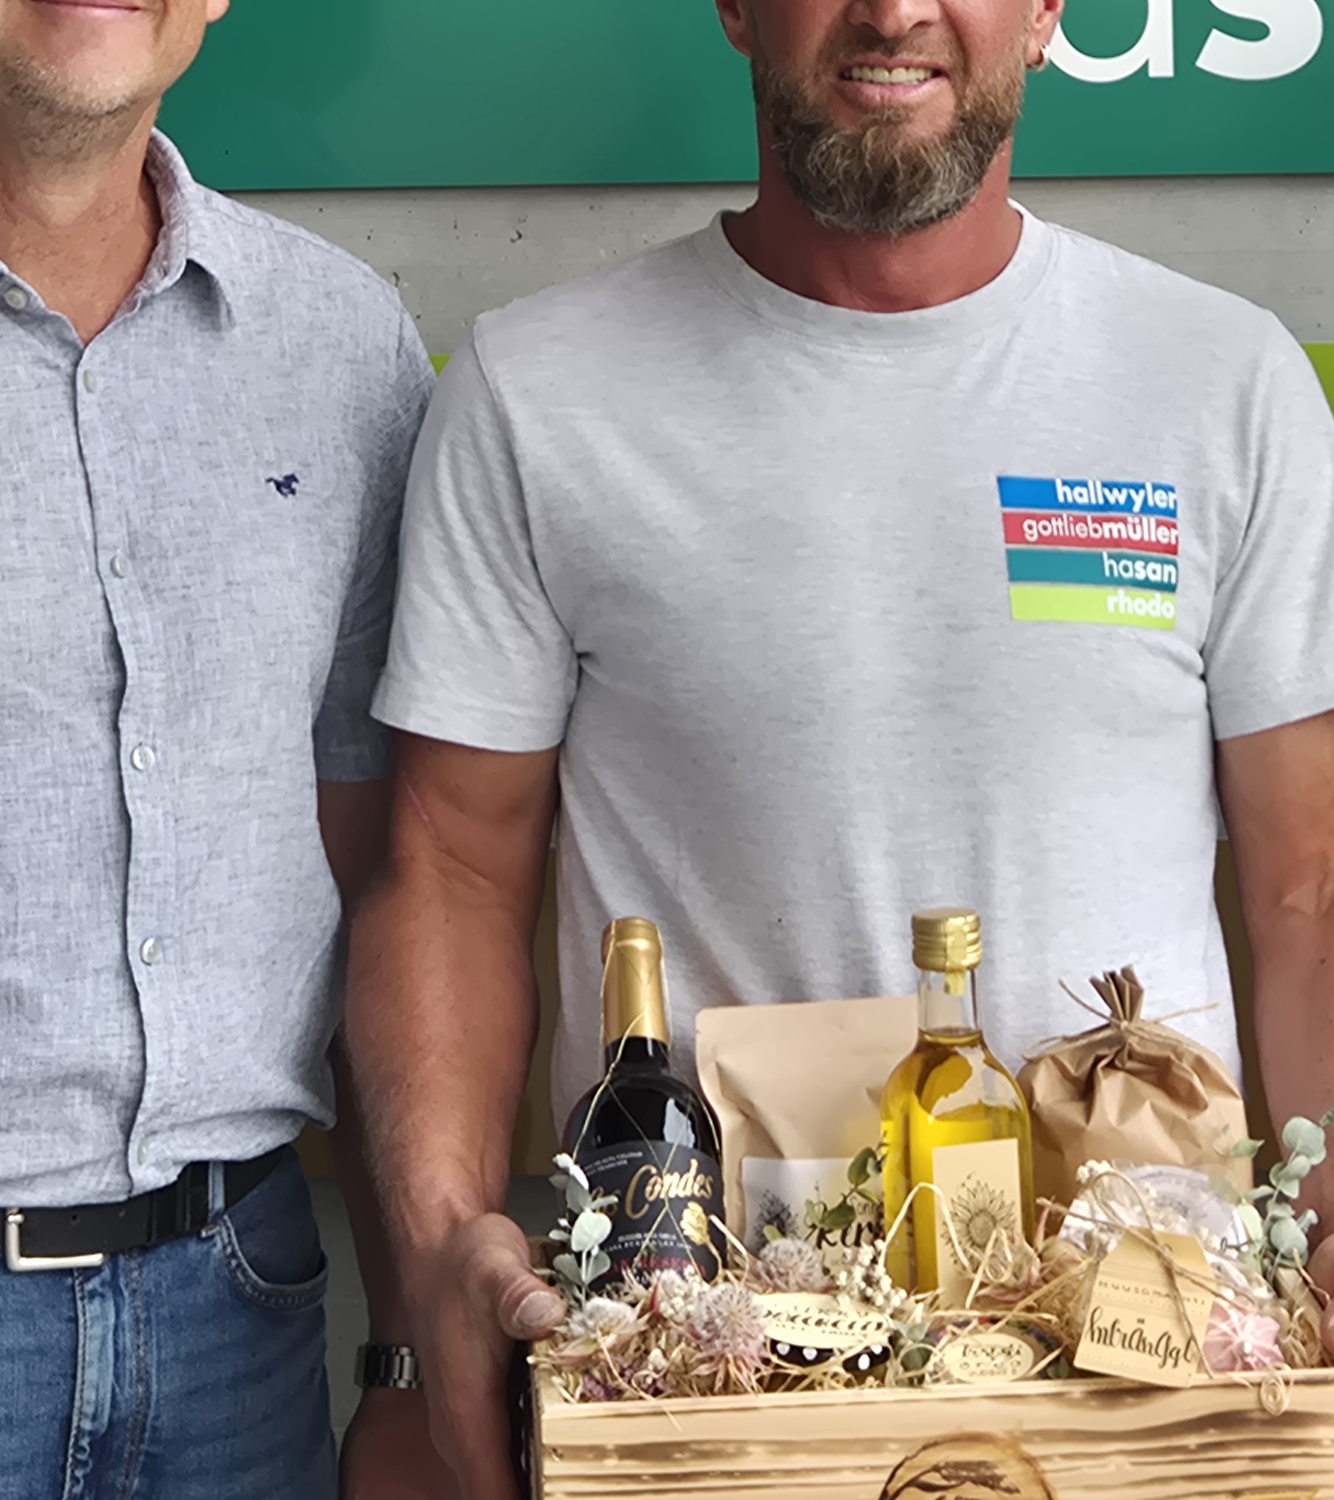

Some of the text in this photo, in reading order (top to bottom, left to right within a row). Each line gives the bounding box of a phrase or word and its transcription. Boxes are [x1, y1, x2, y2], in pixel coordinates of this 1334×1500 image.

[1055, 478, 1178, 513] hallwyler
[1022, 513, 1179, 545] gottliebmüller
[1102, 551, 1176, 584] hasan
[1107, 589, 1175, 619] rhodo
[624, 1158, 714, 1220] Condes
